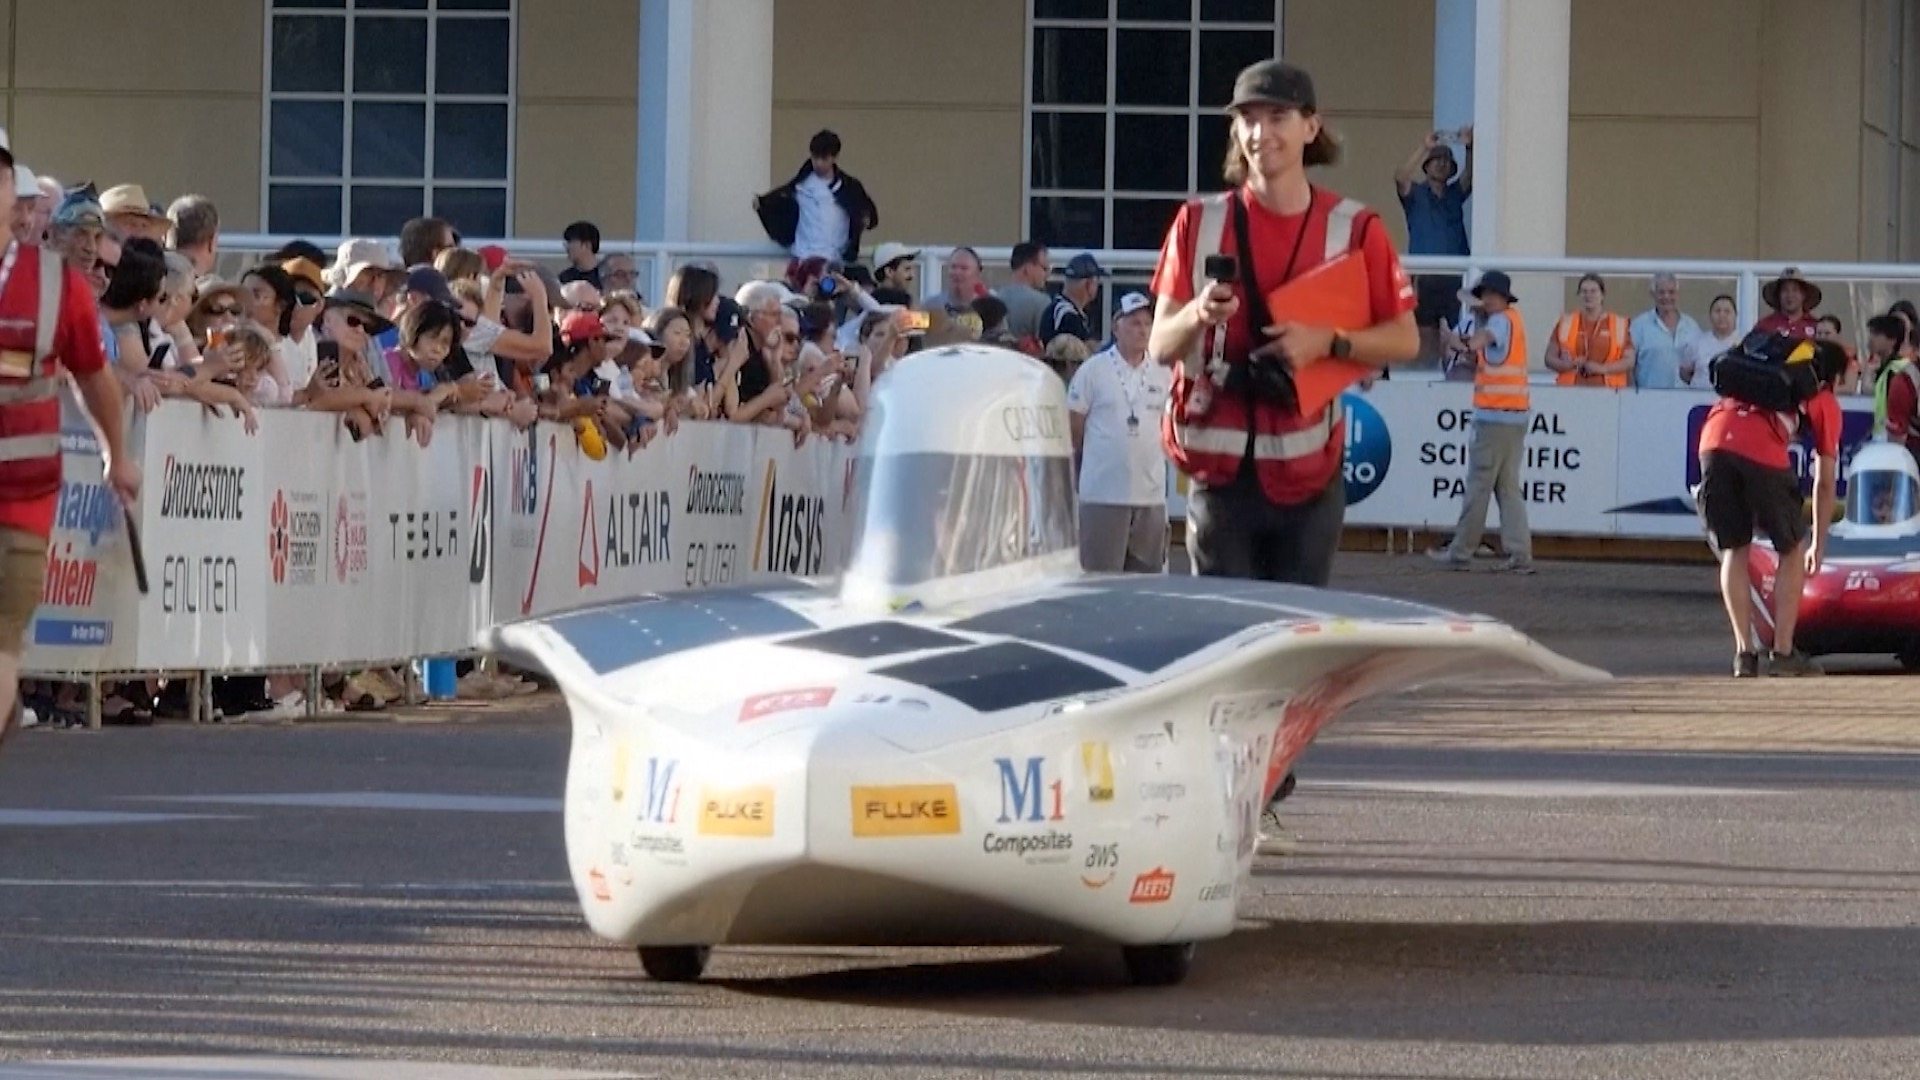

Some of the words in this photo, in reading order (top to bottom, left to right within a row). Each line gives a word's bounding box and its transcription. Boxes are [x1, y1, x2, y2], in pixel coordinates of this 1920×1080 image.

[1436, 409, 1566, 435] OFAL
[1419, 442, 1581, 470] SCIIFIC
[161, 454, 245, 520] BRIDGESTONE
[1432, 476, 1567, 503] PAER
[389, 511, 458, 560] TESLA
[605, 491, 671, 568] ALTAIR
[43, 542, 97, 606] hiem
[163, 556, 237, 613] ENLITEN
[865, 799, 948, 819] FLUKE
[983, 830, 1073, 856] Composites
